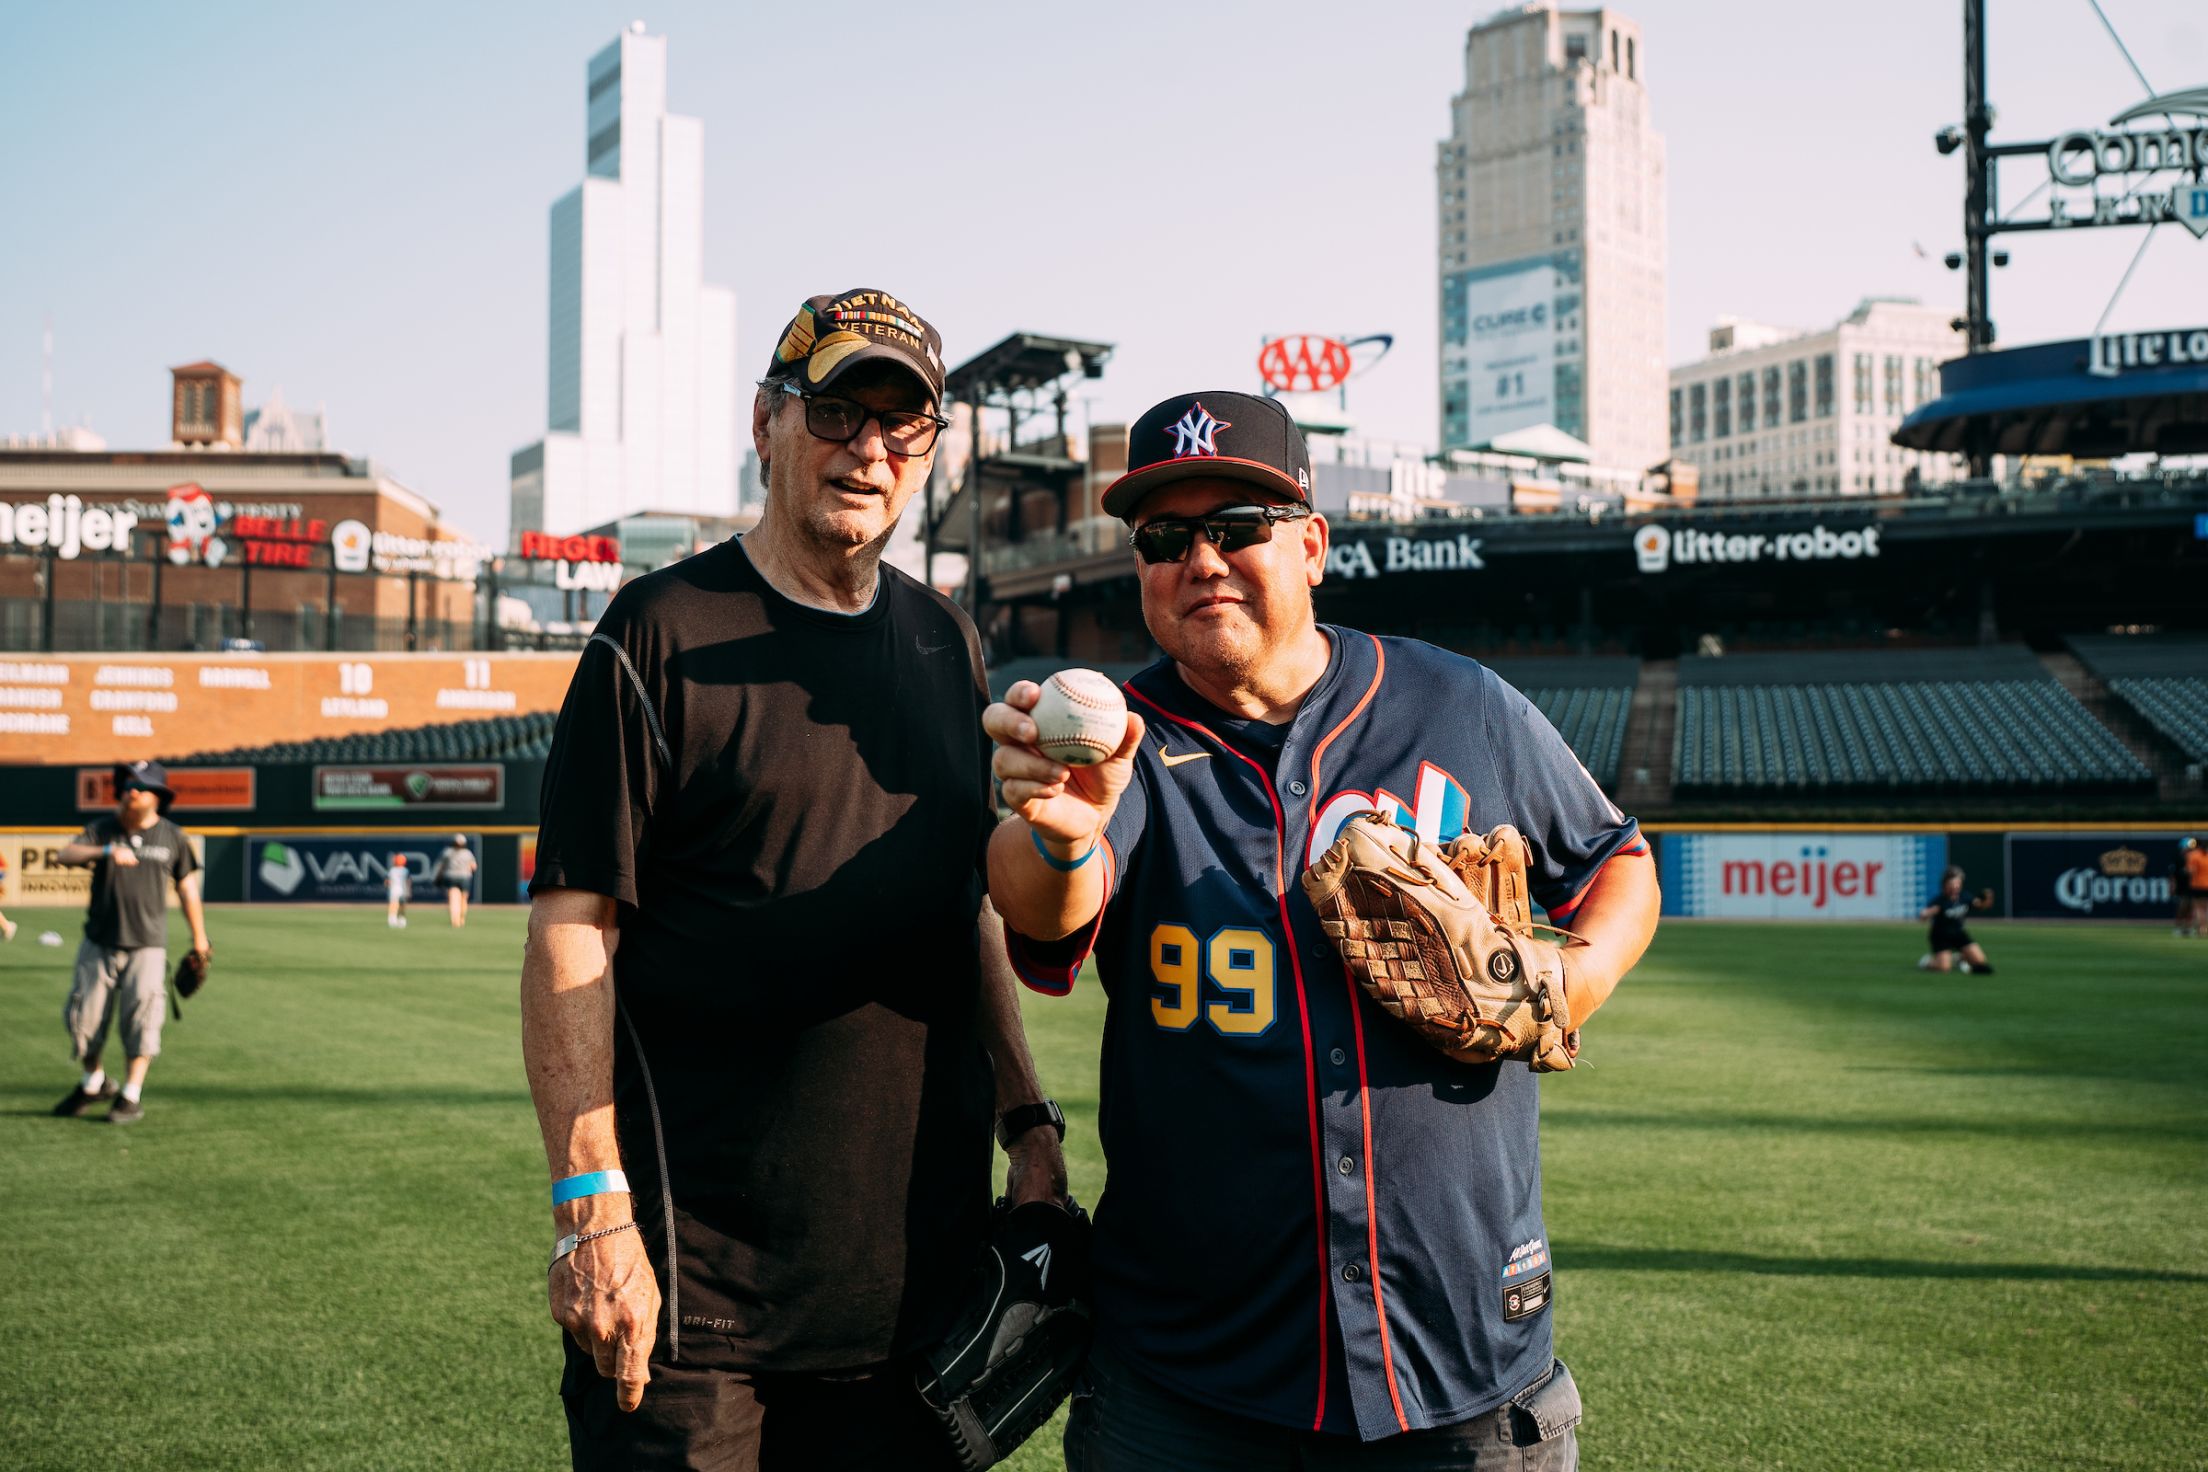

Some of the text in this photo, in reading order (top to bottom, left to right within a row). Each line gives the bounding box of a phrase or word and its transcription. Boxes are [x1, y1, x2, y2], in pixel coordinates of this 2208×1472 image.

[826, 293, 925, 333] VIETNAM
[837, 321, 920, 350] VETERAN
[1259, 335, 1351, 391] AAA
[233, 513, 328, 542] BELLE
[243, 539, 314, 568] TIRE
[1384, 533, 1486, 572] Bank
[556, 558, 625, 592] LAW
[338, 662, 374, 695] 10
[463, 657, 491, 690] 11
[1722, 845, 1884, 909] meijer
[2054, 867, 2172, 914] Coron
[1150, 920, 1278, 1038] 99
[683, 1315, 735, 1330] DRI-FIT
